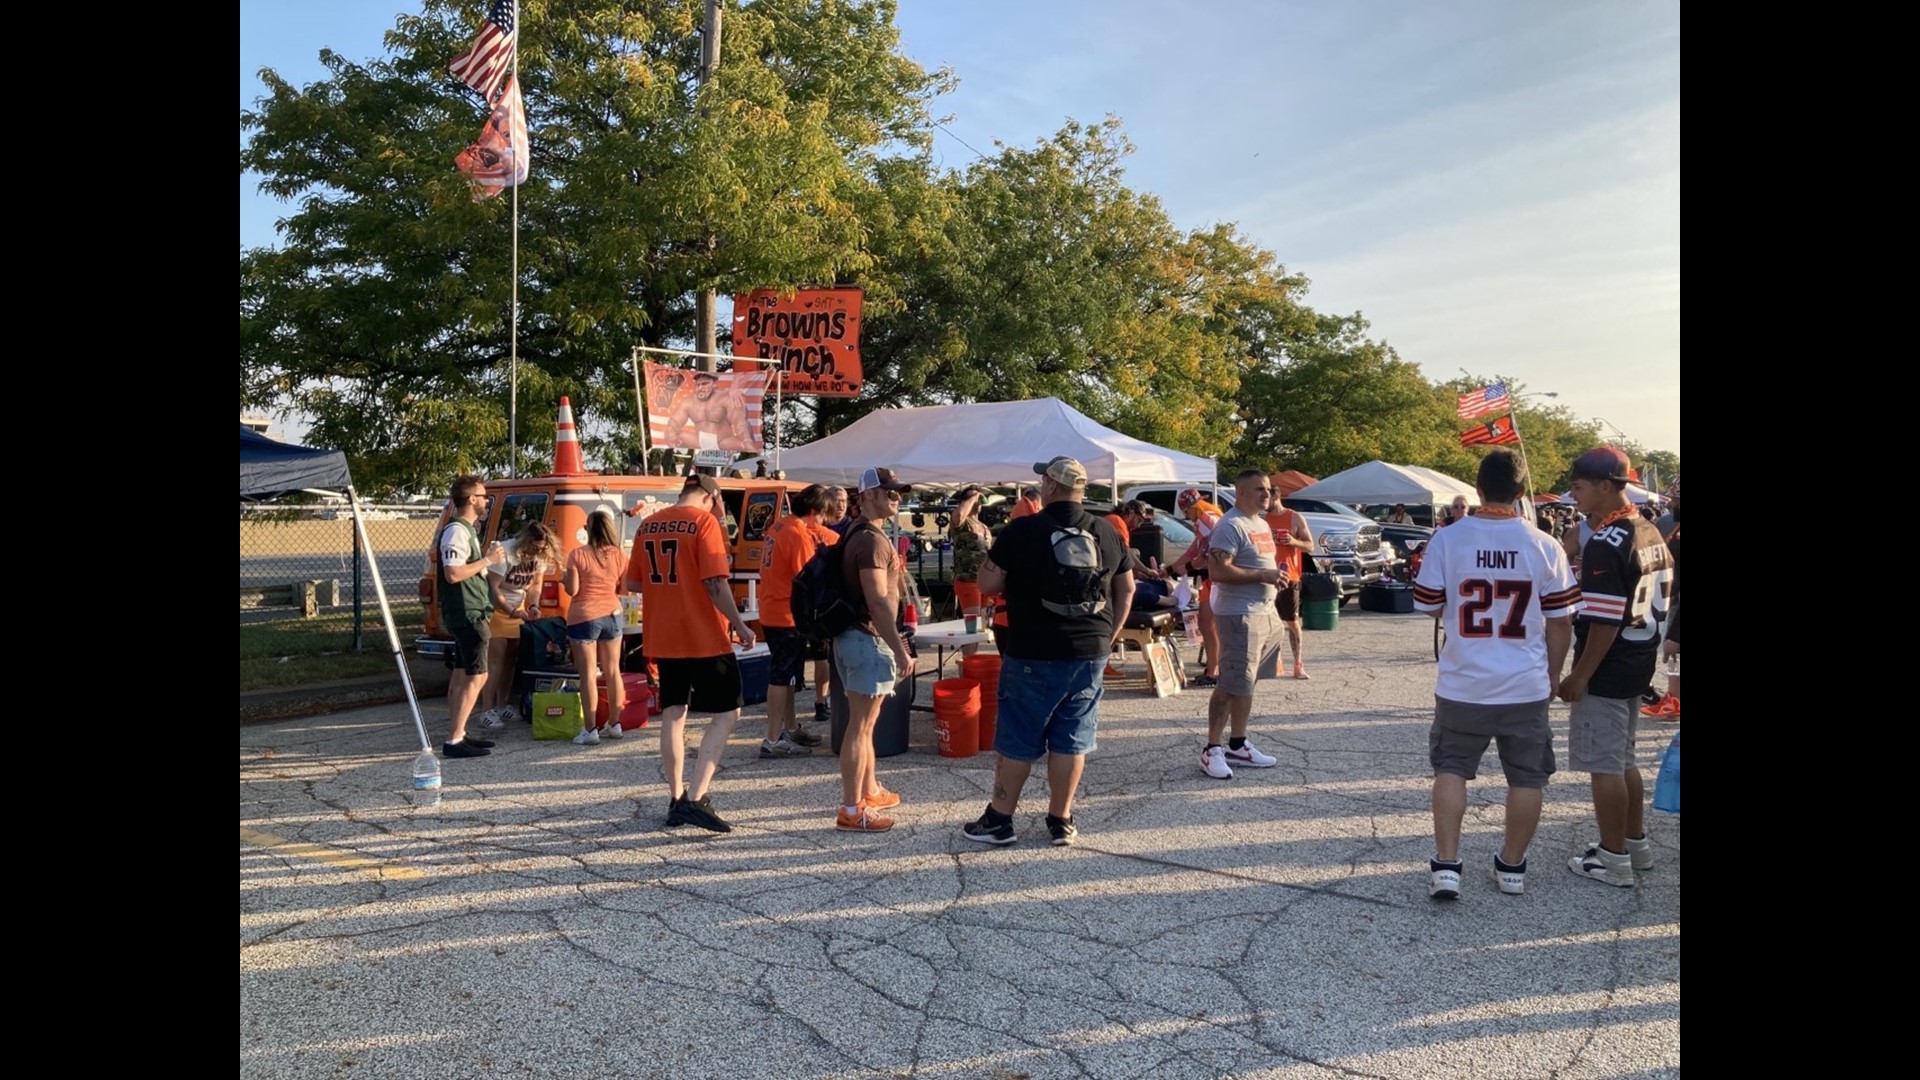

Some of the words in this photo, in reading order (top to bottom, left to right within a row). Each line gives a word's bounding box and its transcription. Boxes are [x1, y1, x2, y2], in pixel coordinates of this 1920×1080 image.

[793, 381, 811, 391] HOW
[815, 381, 828, 391] WE
[1593, 526, 1628, 547] 95
[644, 539, 678, 585] 17
[1476, 550, 1519, 569] HUNT
[1458, 578, 1533, 639] 27
